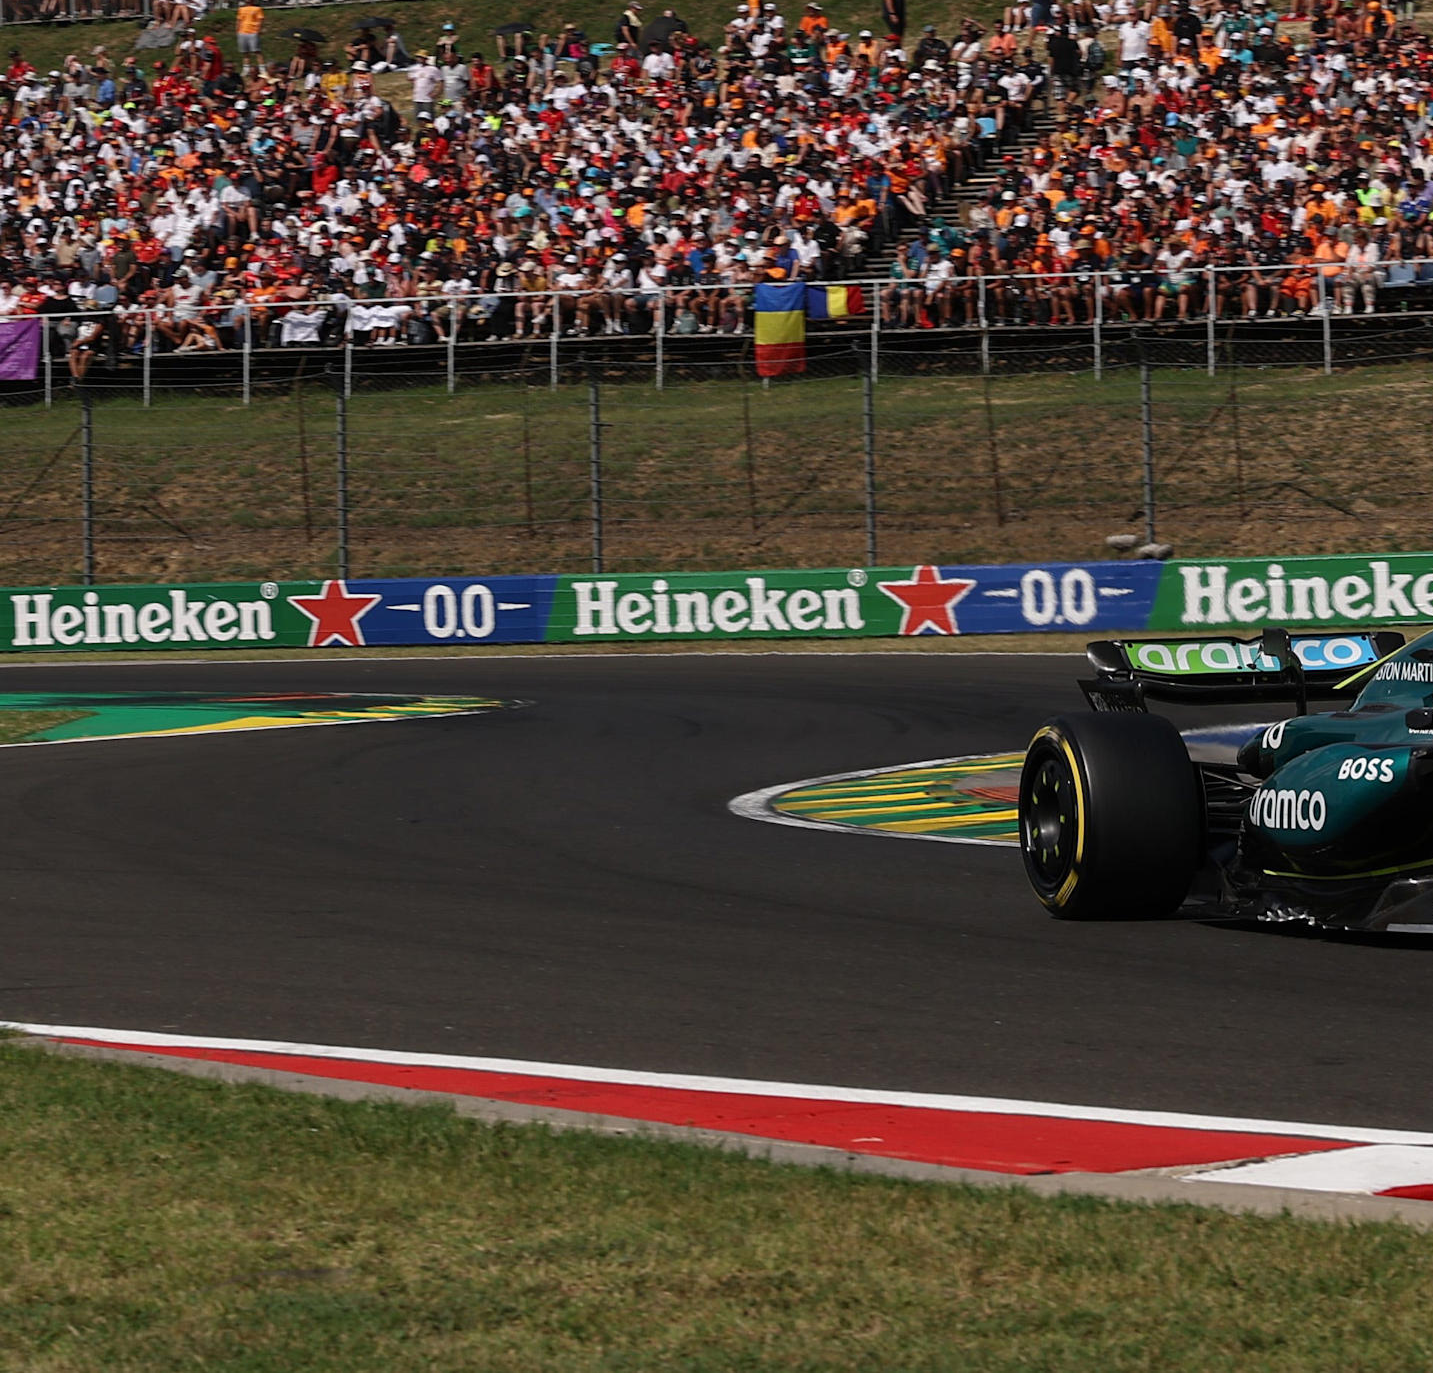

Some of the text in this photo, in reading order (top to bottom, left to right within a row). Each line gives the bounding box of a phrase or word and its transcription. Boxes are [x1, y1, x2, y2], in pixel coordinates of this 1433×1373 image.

[11, 585, 495, 645] Heineken 0.0
[572, 569, 1096, 634] Heineken 0.0
[1374, 662, 1401, 681] STON
[1337, 757, 1395, 783] BOSS
[1249, 788, 1327, 831] aramco
